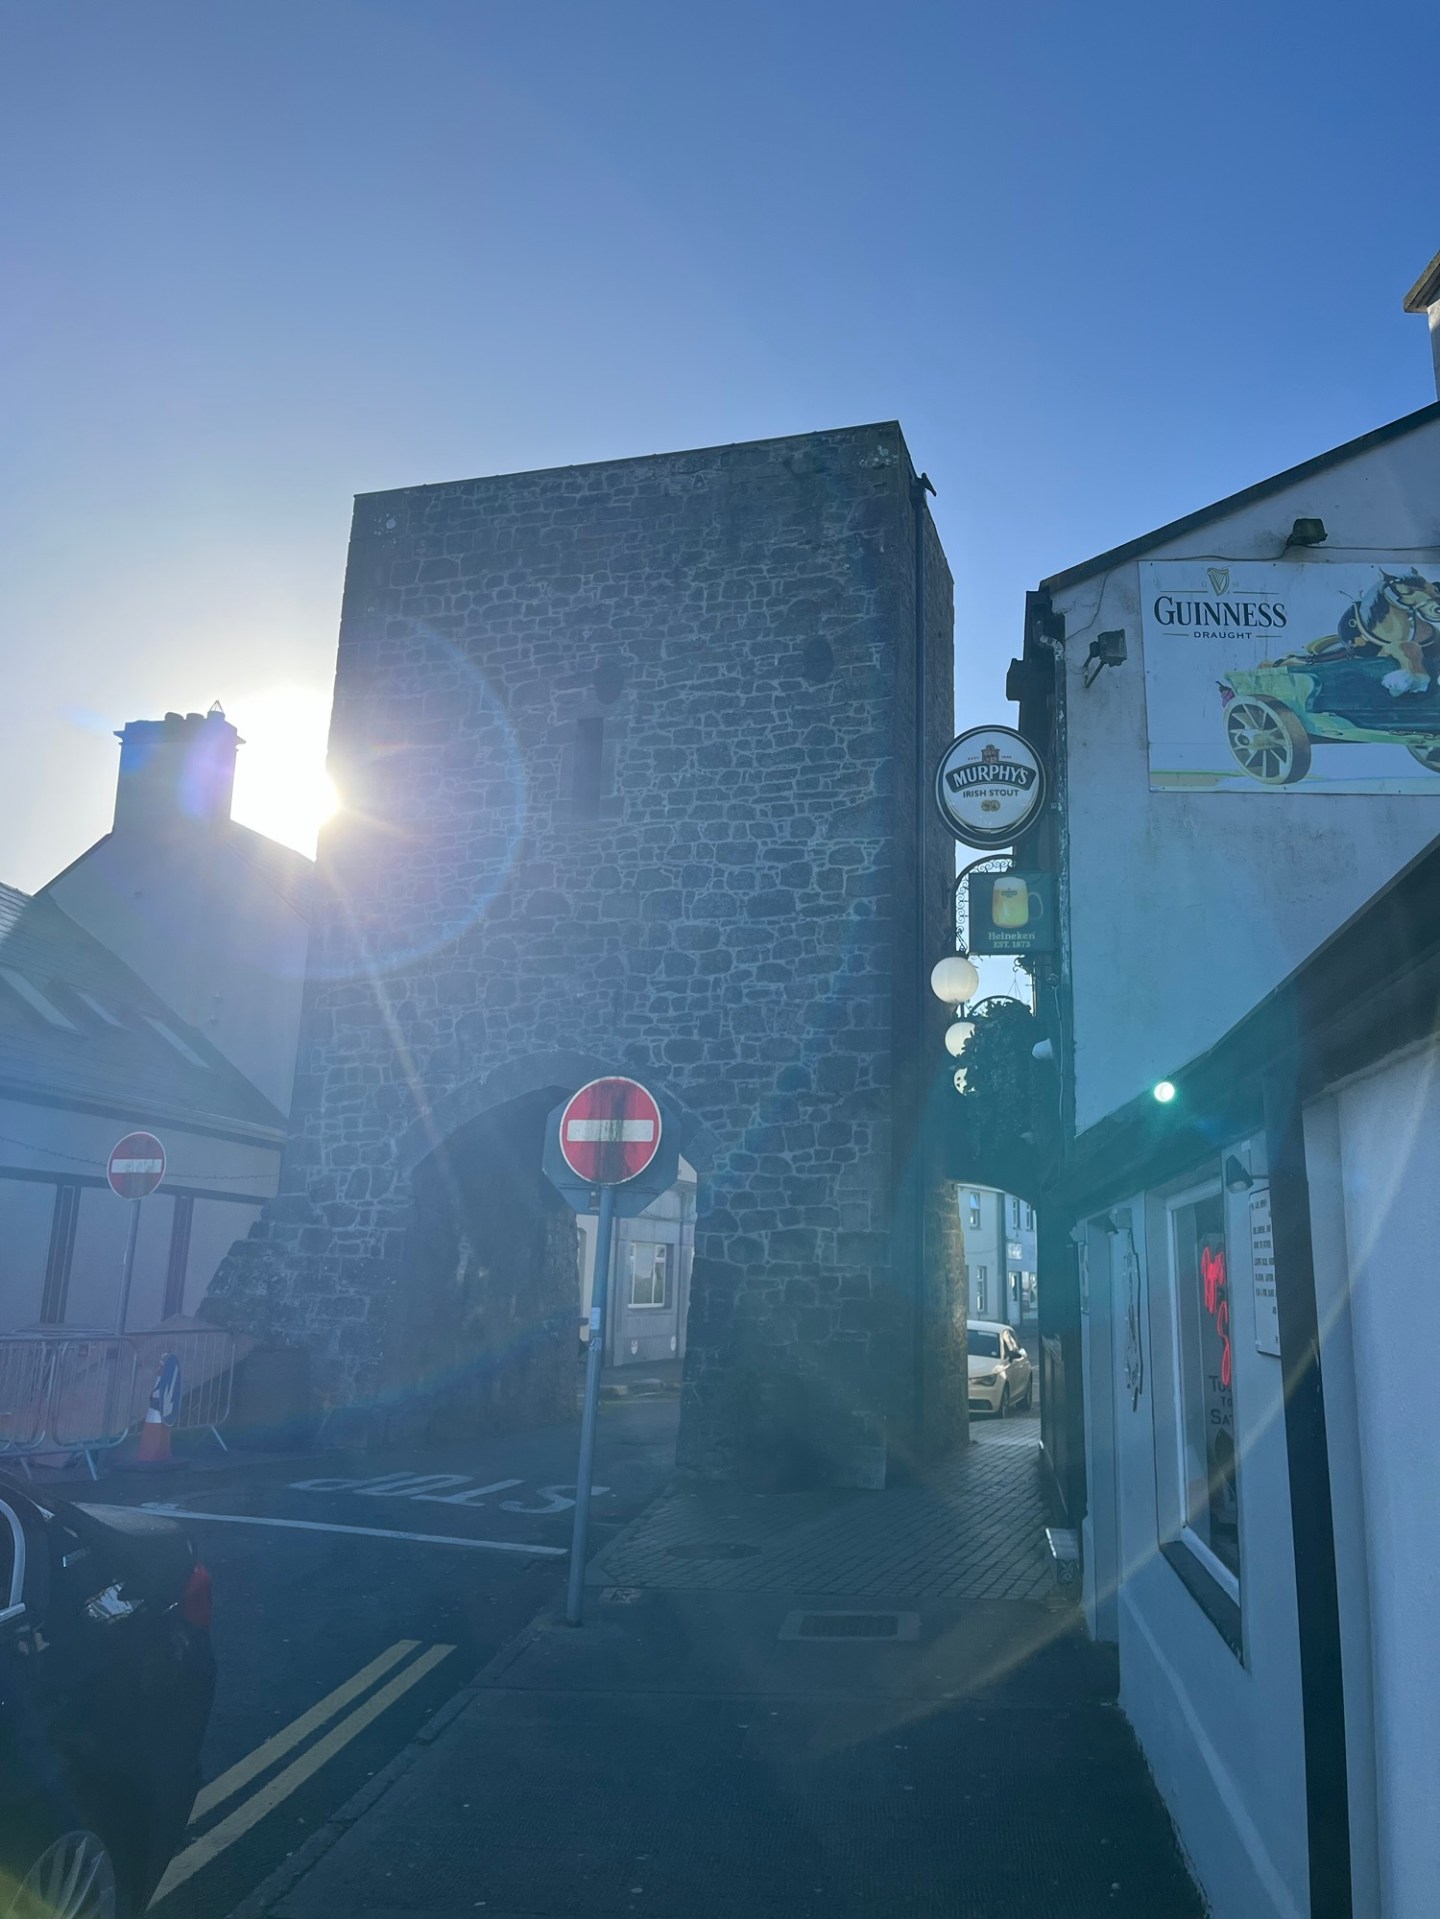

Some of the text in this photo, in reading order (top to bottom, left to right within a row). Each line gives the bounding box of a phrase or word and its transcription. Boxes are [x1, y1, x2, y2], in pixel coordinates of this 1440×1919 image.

[1154, 596, 1287, 628] GUINNESS
[1193, 631, 1252, 640] DRAUGHT
[963, 789, 1019, 798] IRISH STOUT
[988, 931, 1035, 941] Heineken
